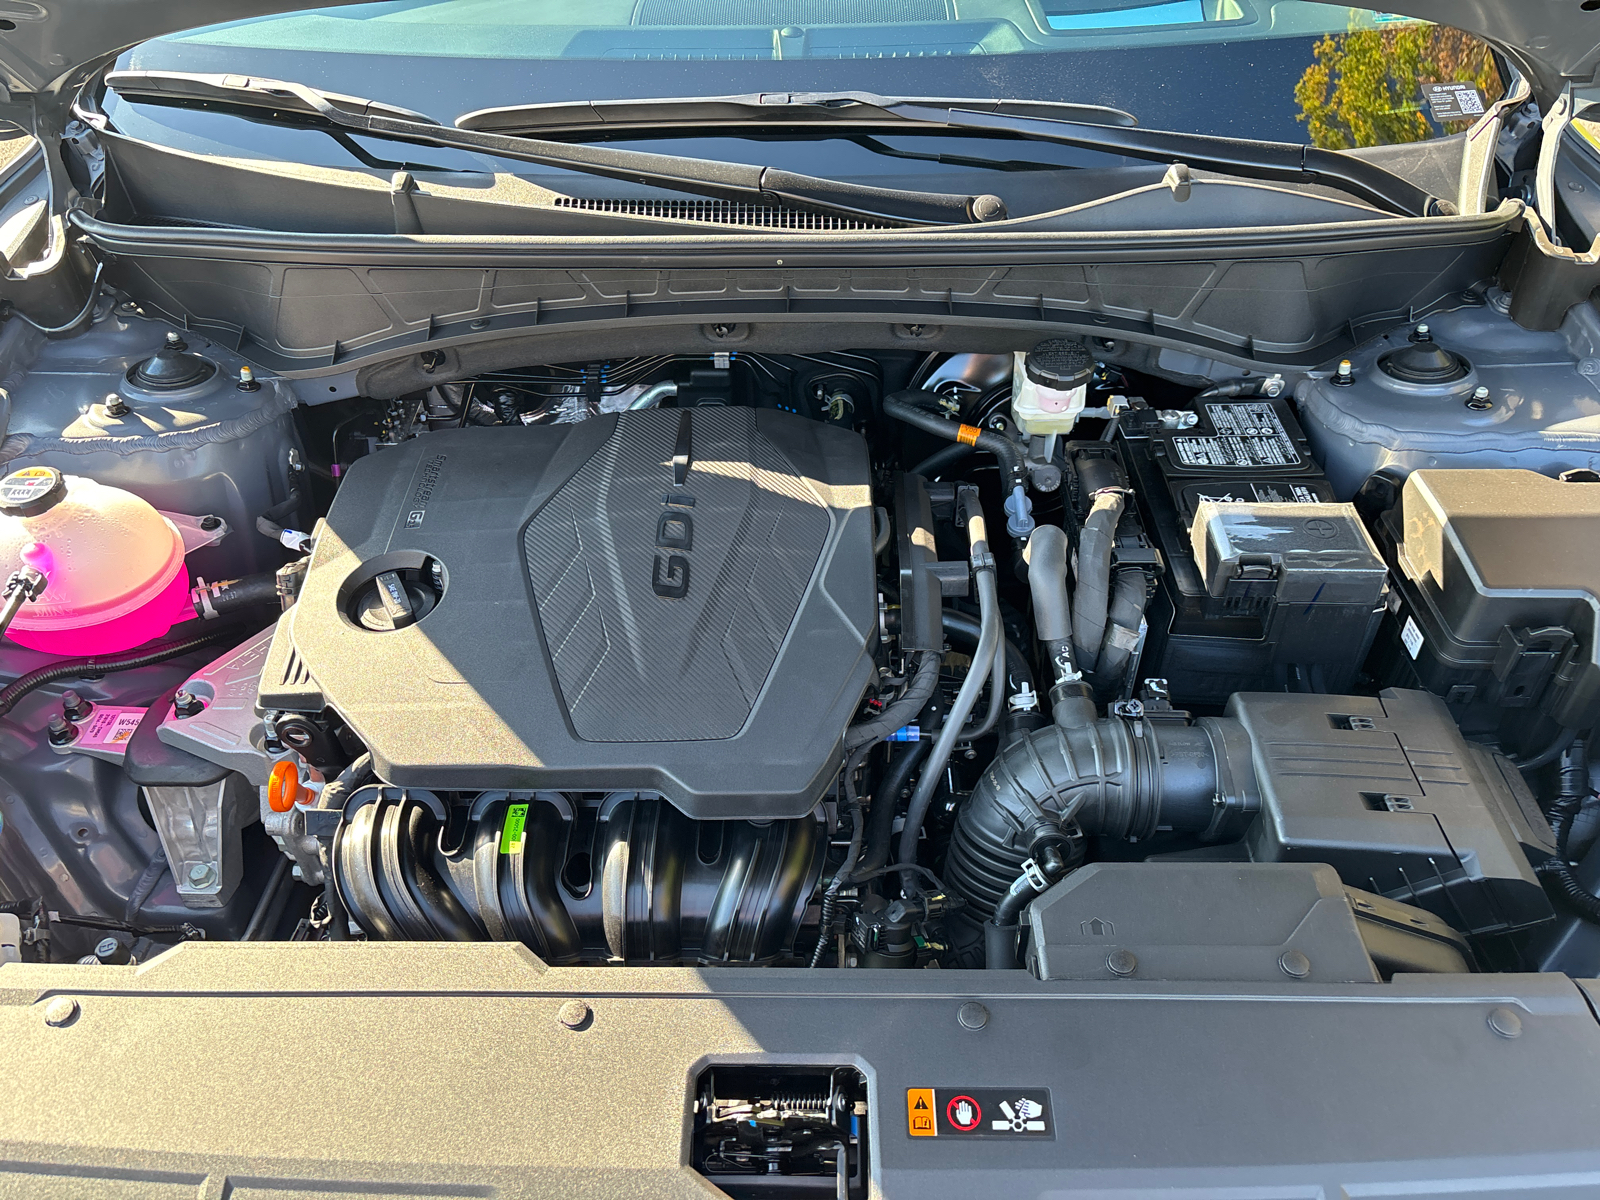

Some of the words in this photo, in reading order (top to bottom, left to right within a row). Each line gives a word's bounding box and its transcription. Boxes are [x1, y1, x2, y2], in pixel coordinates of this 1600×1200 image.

[1442, 84, 1467, 92] HYUNDAI
[419, 454, 447, 508] Smartstream
[118, 718, 140, 726] W545
